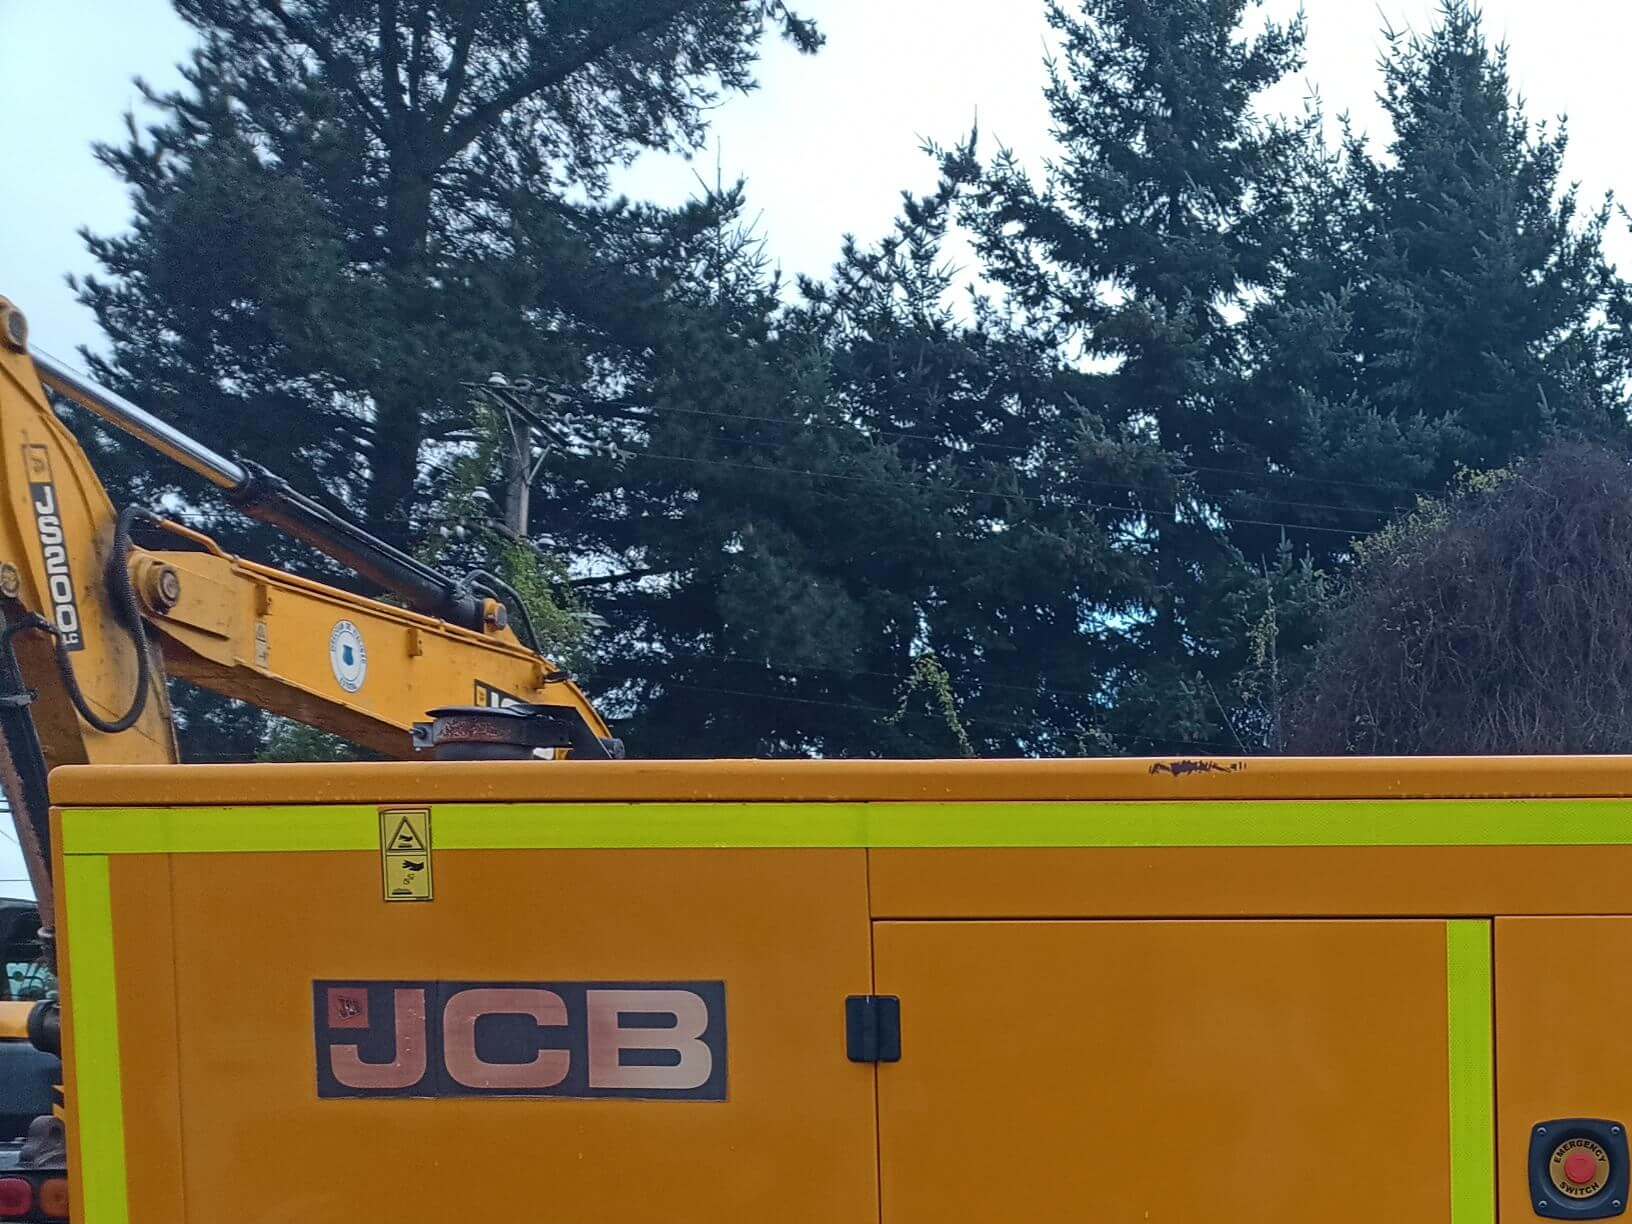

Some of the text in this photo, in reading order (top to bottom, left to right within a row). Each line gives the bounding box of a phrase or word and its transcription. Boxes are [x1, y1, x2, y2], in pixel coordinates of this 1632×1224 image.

[35, 486, 77, 632] JS200
[330, 988, 712, 1089] JCB
[1553, 1140, 1607, 1163] EMERGENCY
[1559, 1181, 1600, 1195] SWITCH
